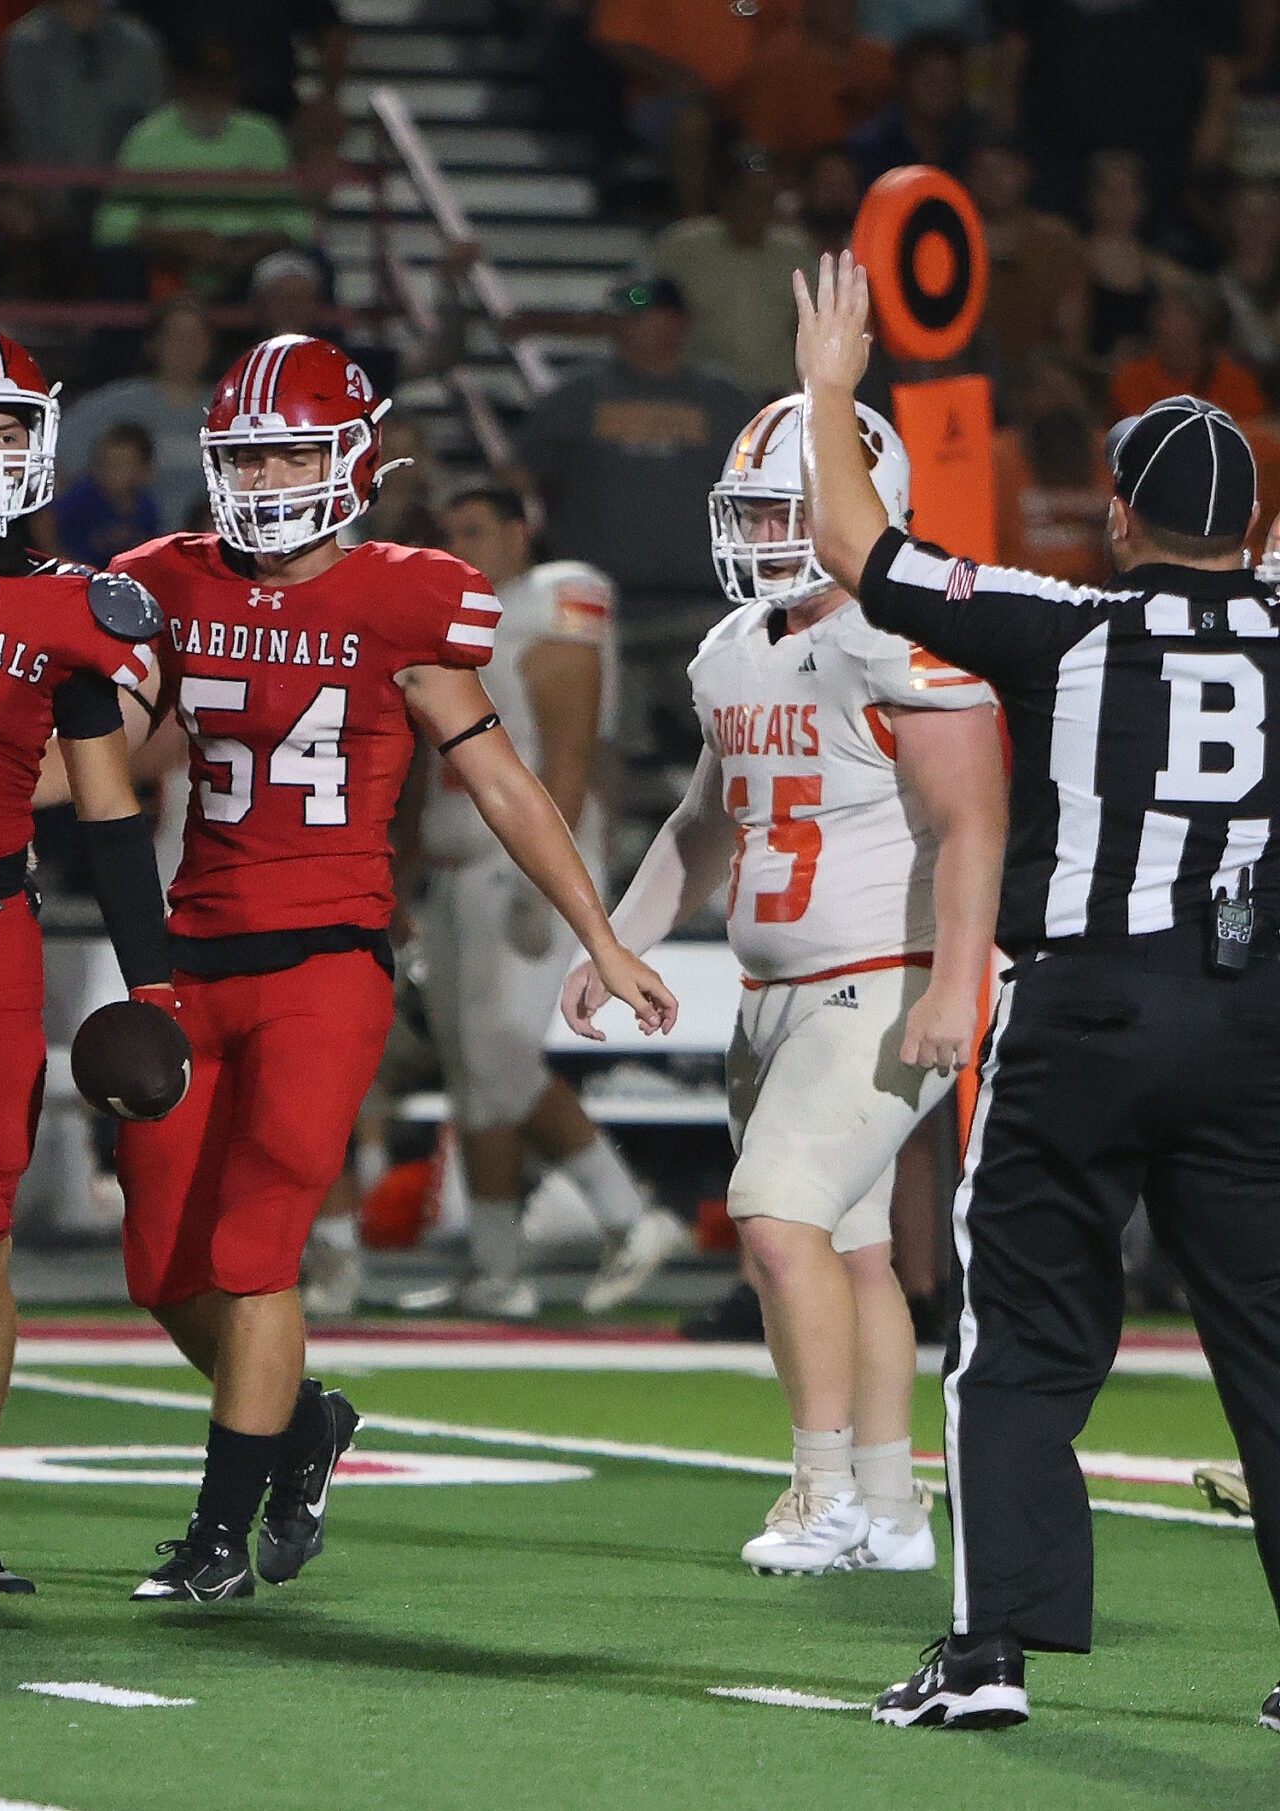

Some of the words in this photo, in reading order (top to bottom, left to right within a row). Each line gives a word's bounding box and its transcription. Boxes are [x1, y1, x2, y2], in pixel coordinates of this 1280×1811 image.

[170, 618, 361, 668] CARDINALS
[1201, 611, 1215, 629] S
[178, 675, 349, 827] 54
[1154, 652, 1266, 803] B
